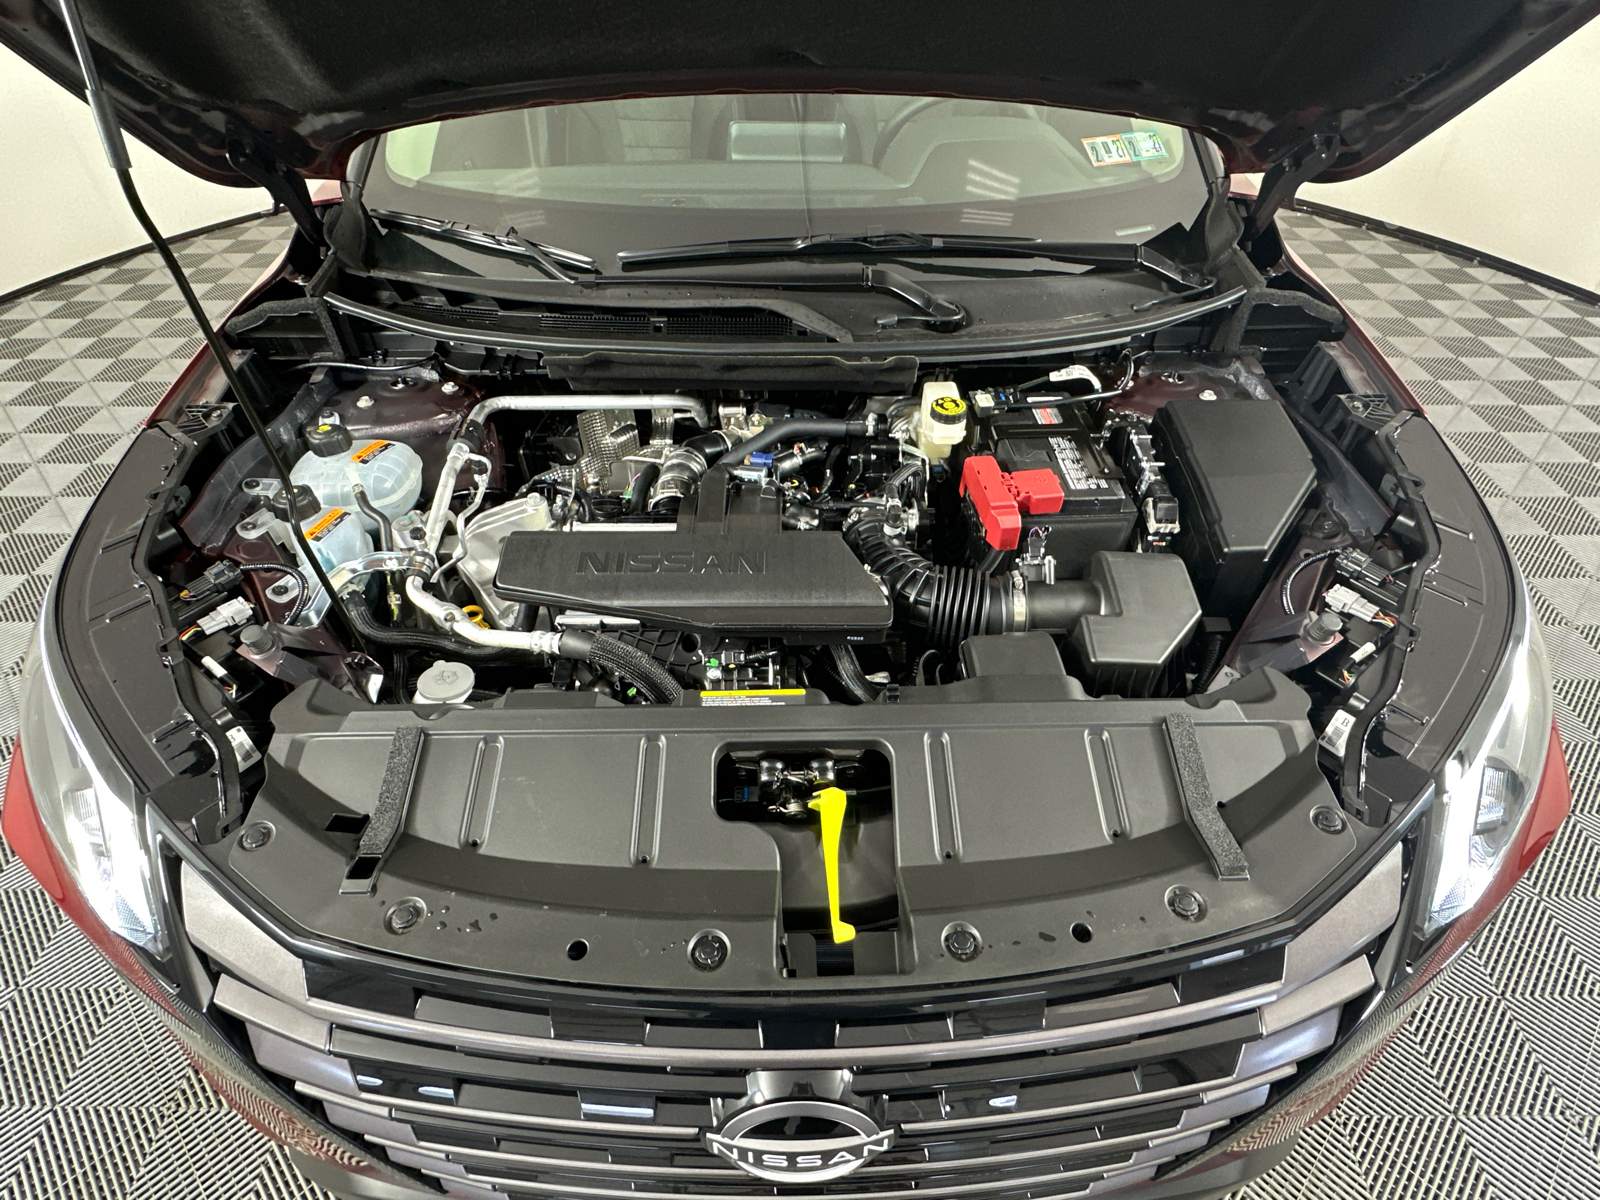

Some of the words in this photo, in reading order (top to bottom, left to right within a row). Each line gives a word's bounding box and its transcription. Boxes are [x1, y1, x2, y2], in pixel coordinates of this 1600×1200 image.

[1090, 145, 1103, 163] 2
[1111, 138, 1127, 159] 27
[1128, 140, 1140, 157] 2
[575, 549, 768, 576] NISSAN
[712, 1137, 890, 1168] NISSAN
